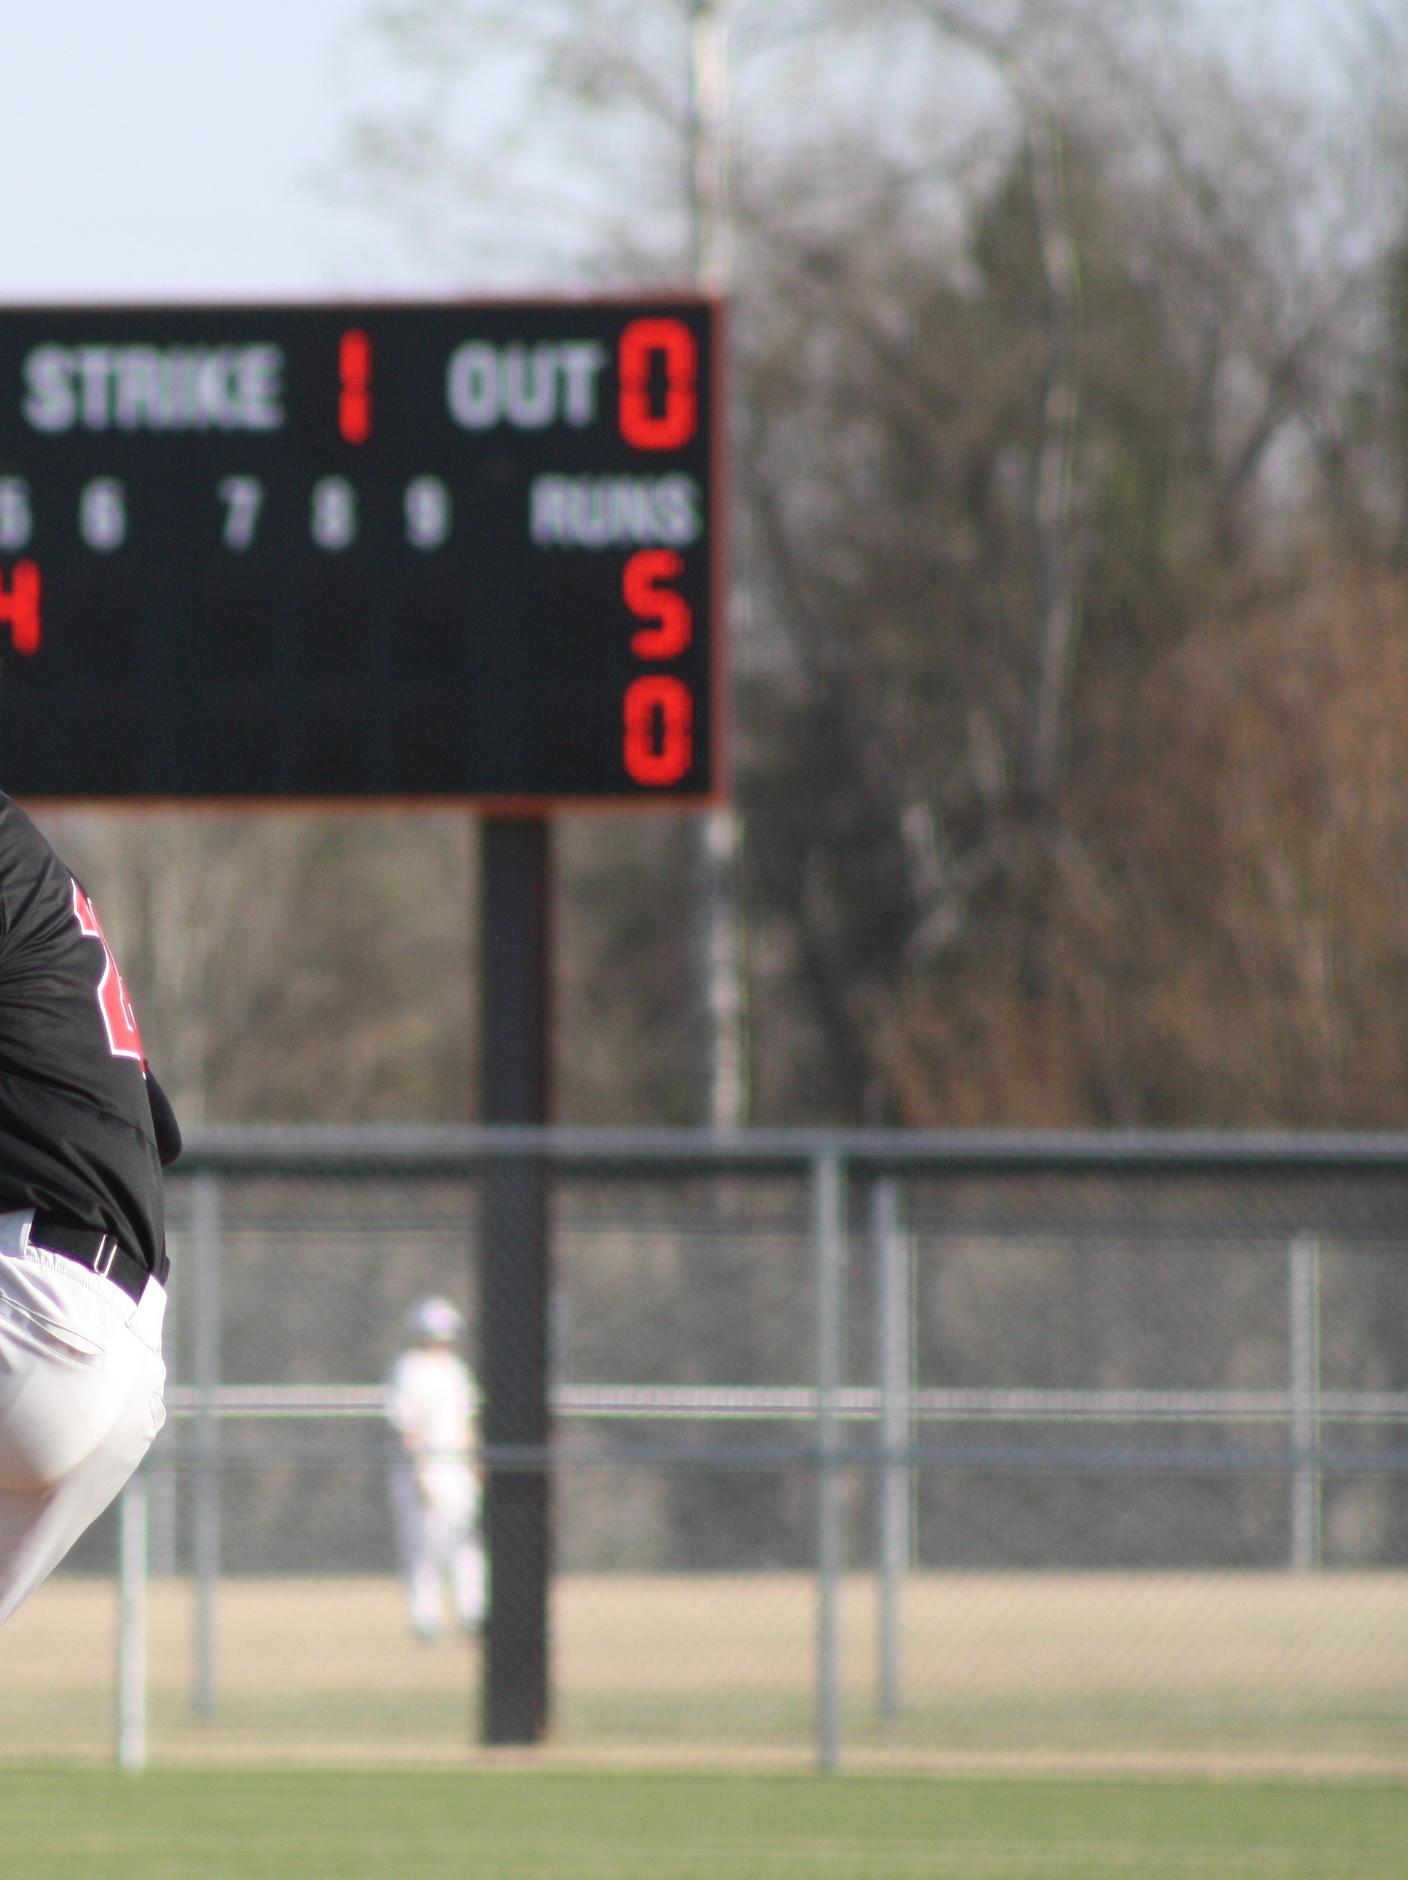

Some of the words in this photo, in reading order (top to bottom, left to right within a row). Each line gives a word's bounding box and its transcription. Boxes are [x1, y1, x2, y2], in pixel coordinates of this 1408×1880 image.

[23, 343, 284, 431] STRIKE
[445, 341, 605, 429] OUT
[618, 318, 697, 451] 0
[80, 477, 125, 552] 6
[219, 477, 263, 551] 7
[311, 477, 354, 551] 8
[404, 476, 449, 549] 9
[530, 474, 700, 546] RUNS
[623, 674, 693, 786] 0
